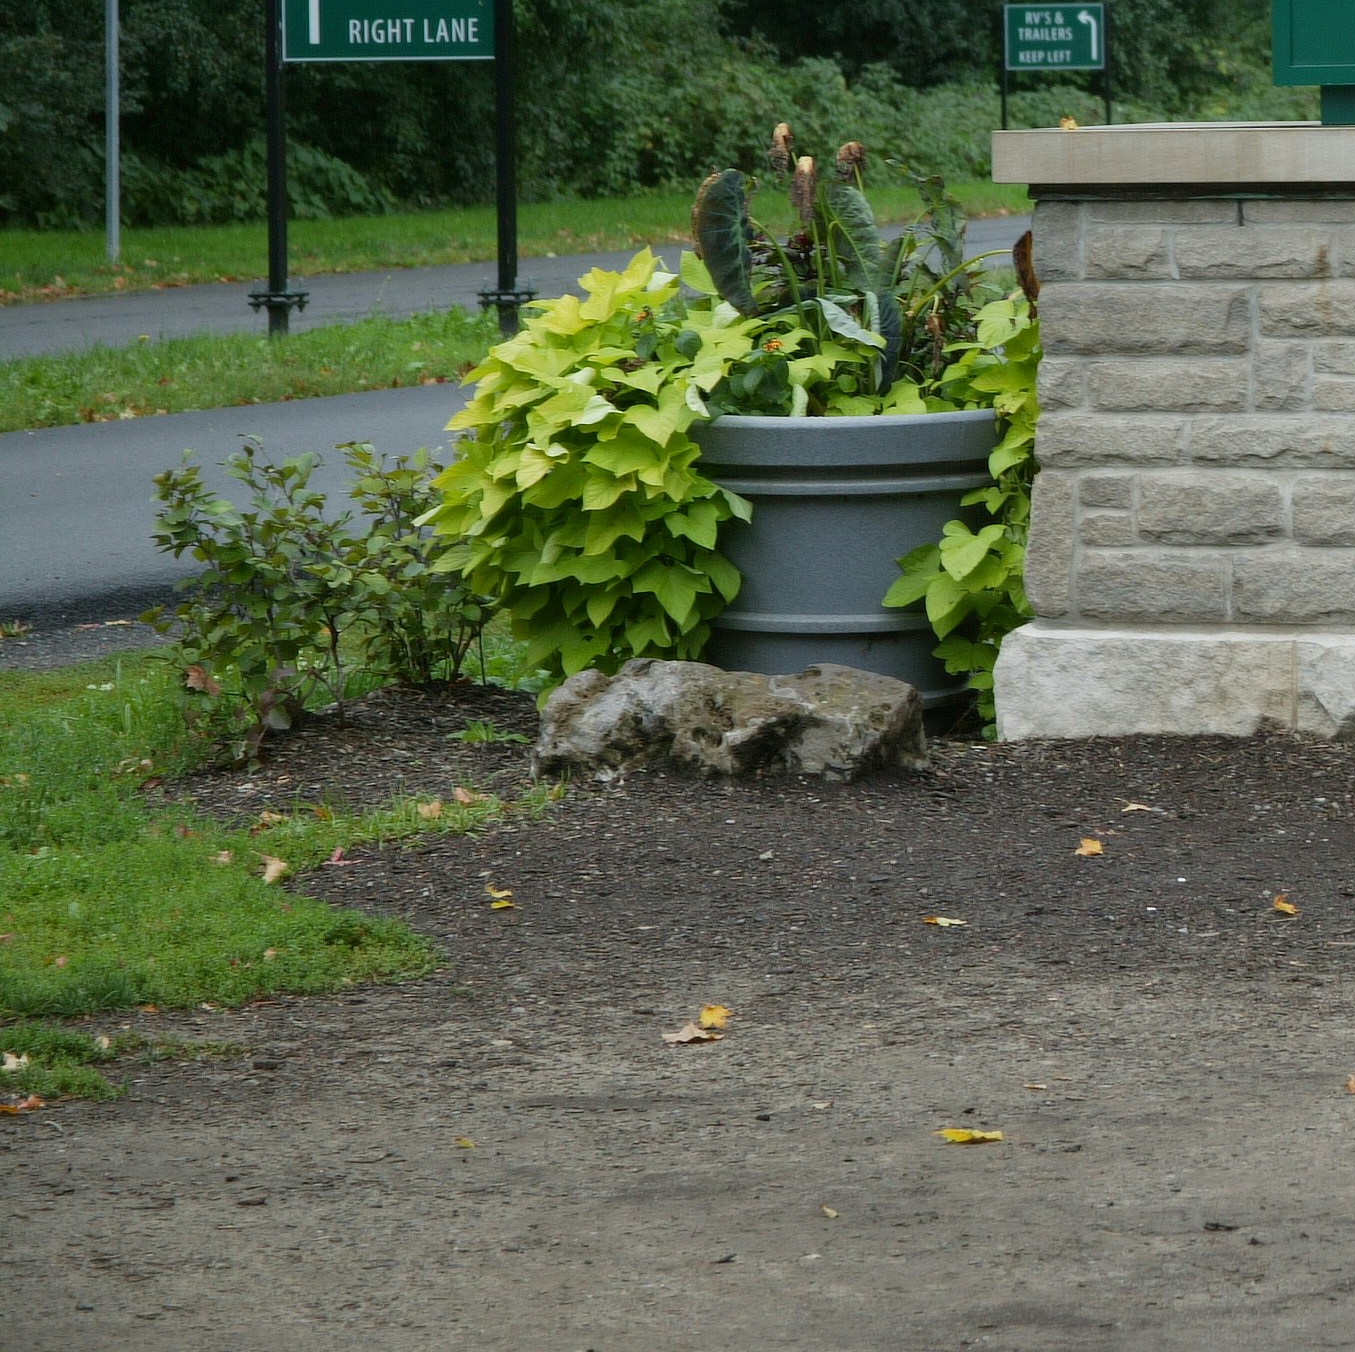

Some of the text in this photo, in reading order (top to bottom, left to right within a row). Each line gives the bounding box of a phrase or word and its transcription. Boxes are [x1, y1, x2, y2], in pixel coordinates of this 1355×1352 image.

[1054, 11, 1064, 25] &
[349, 17, 479, 44] RIGHT LANE
[1018, 27, 1073, 41] TRAILERS
[1018, 50, 1071, 64] KEEP LEFT
